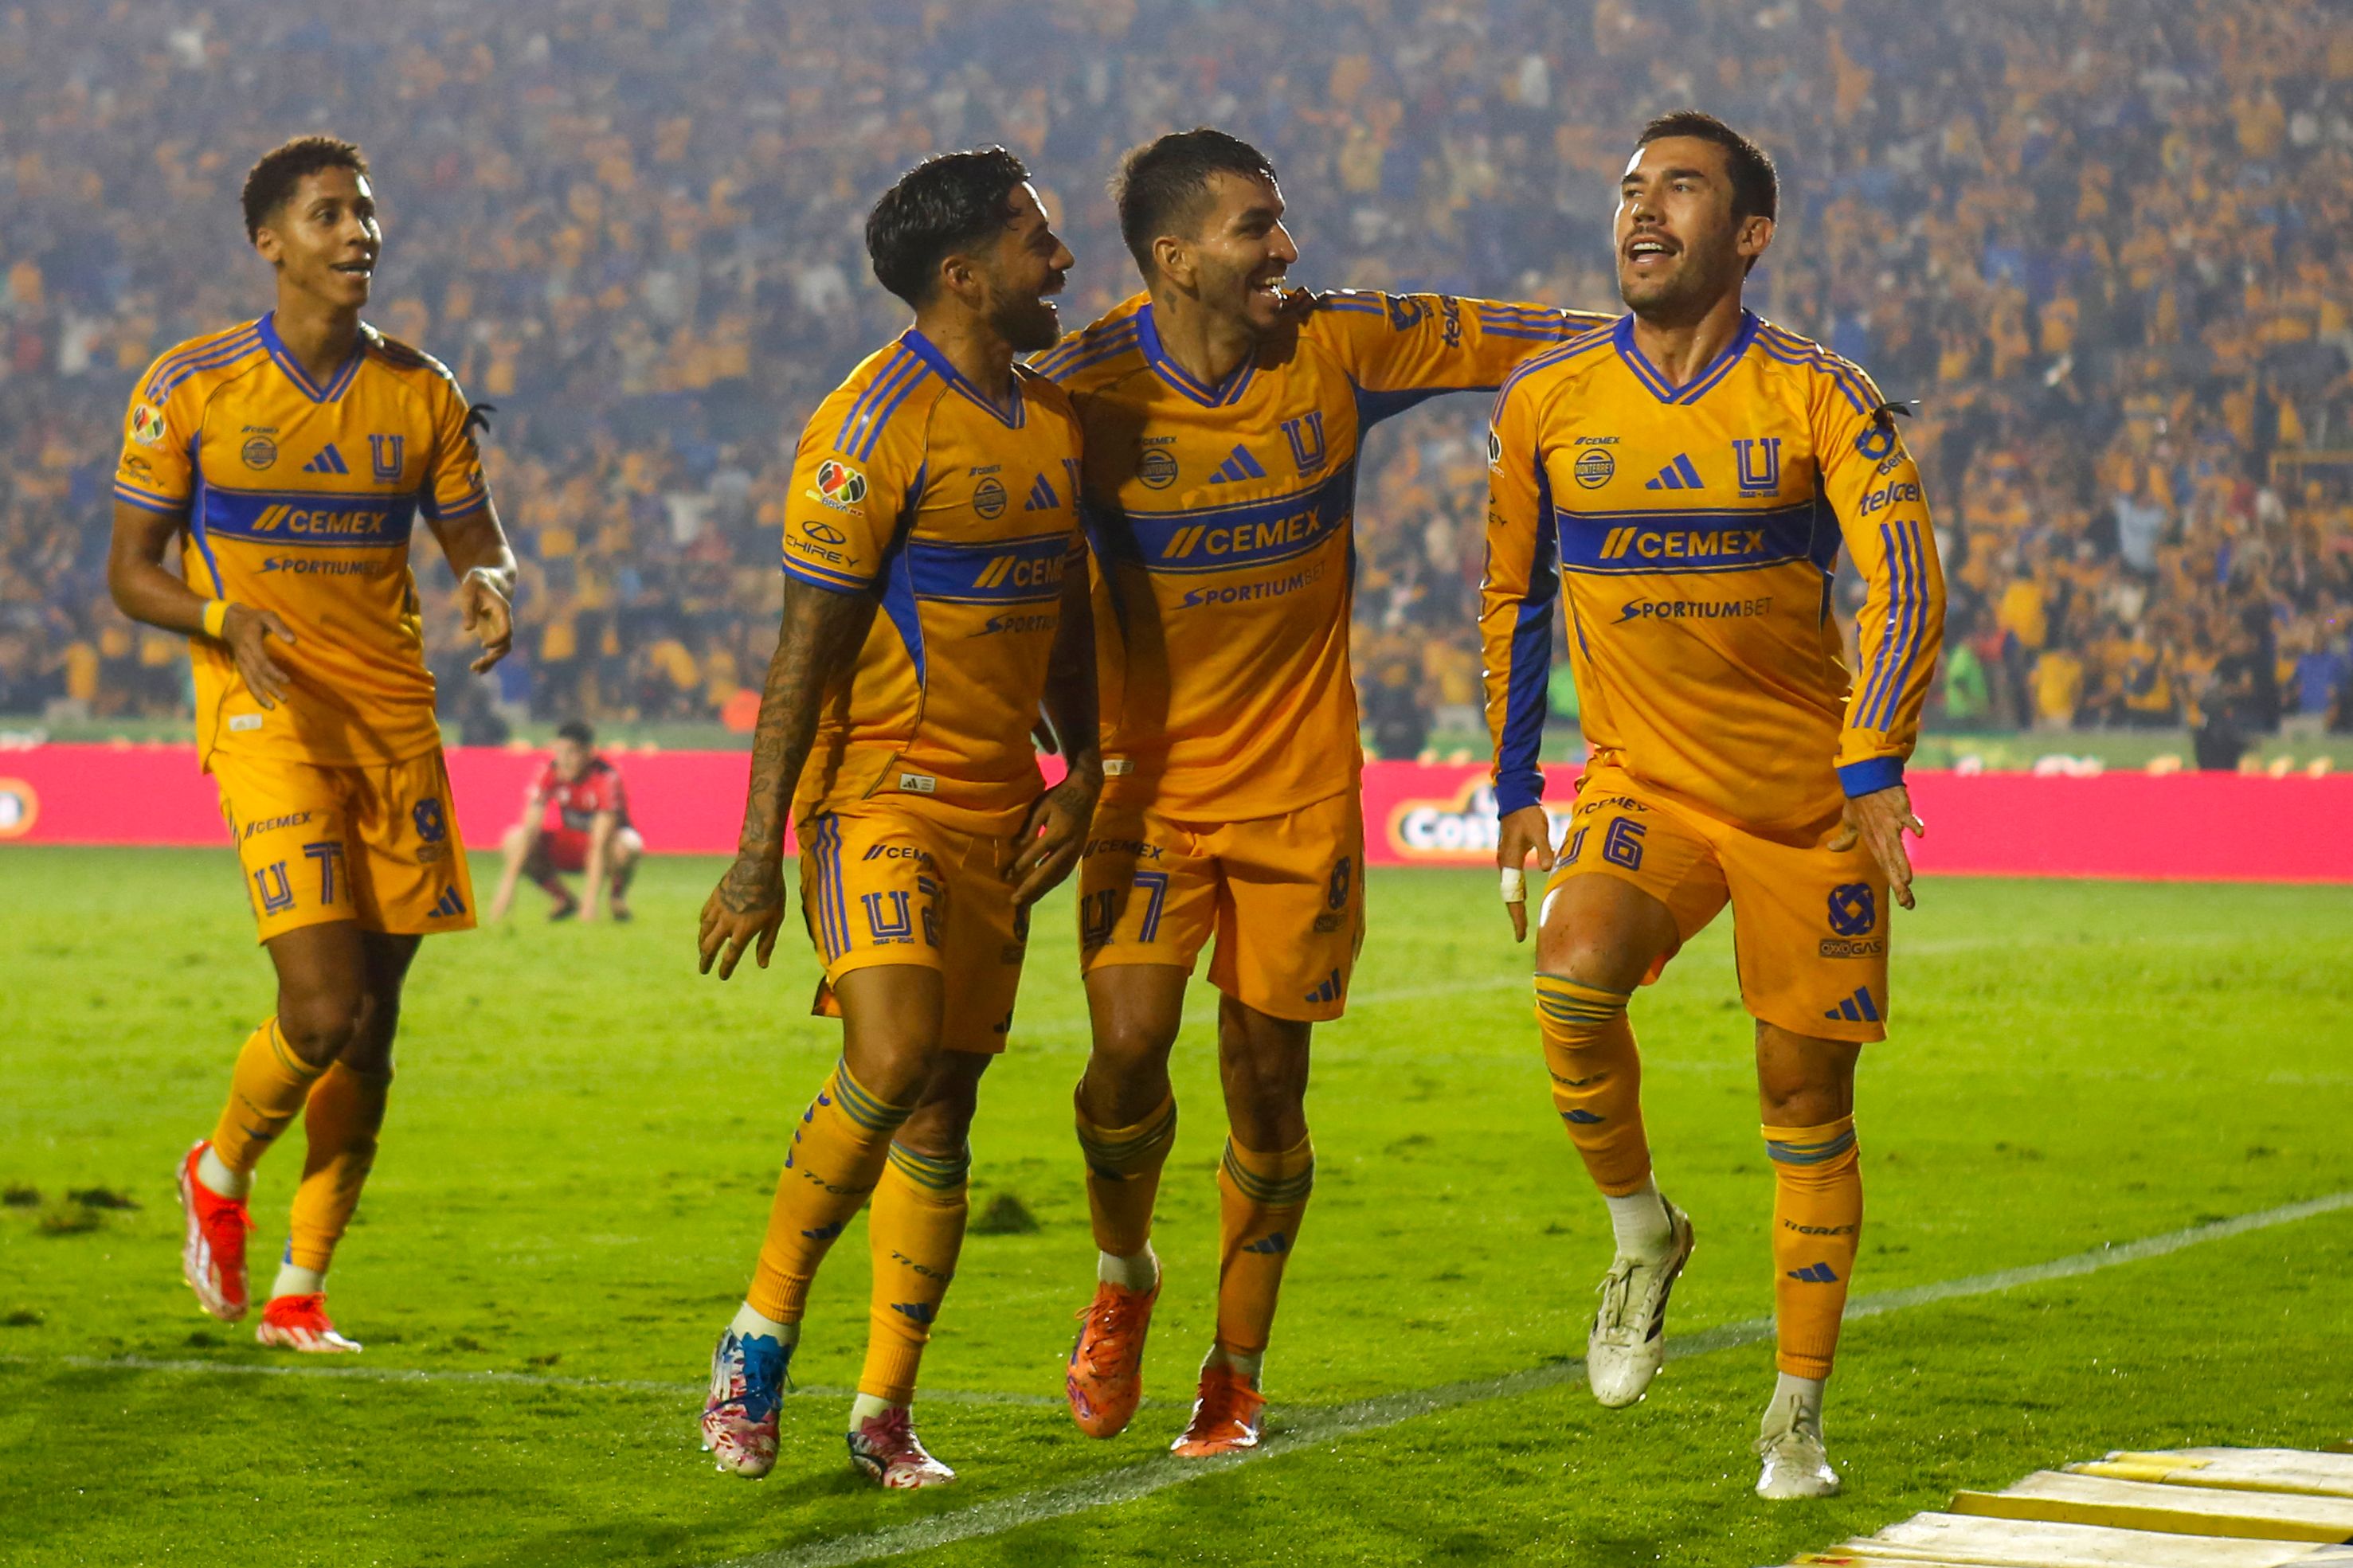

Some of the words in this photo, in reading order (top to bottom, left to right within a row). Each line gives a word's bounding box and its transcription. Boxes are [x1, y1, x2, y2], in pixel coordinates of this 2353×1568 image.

[1280, 410, 1325, 468] U
[1732, 438, 1780, 490] U
[821, 497, 848, 512] BBVA
[1861, 481, 1920, 517] telcel
[288, 510, 387, 534] CEMEX
[1205, 510, 1321, 555] CEMEX
[786, 534, 859, 568] CHIREY
[1637, 529, 1764, 559] CEMEX
[1013, 555, 1064, 587] CEM
[256, 812, 311, 833] CEMEX
[1603, 816, 1646, 872] 6
[861, 891, 913, 937] U
[1133, 870, 1169, 943] 7
